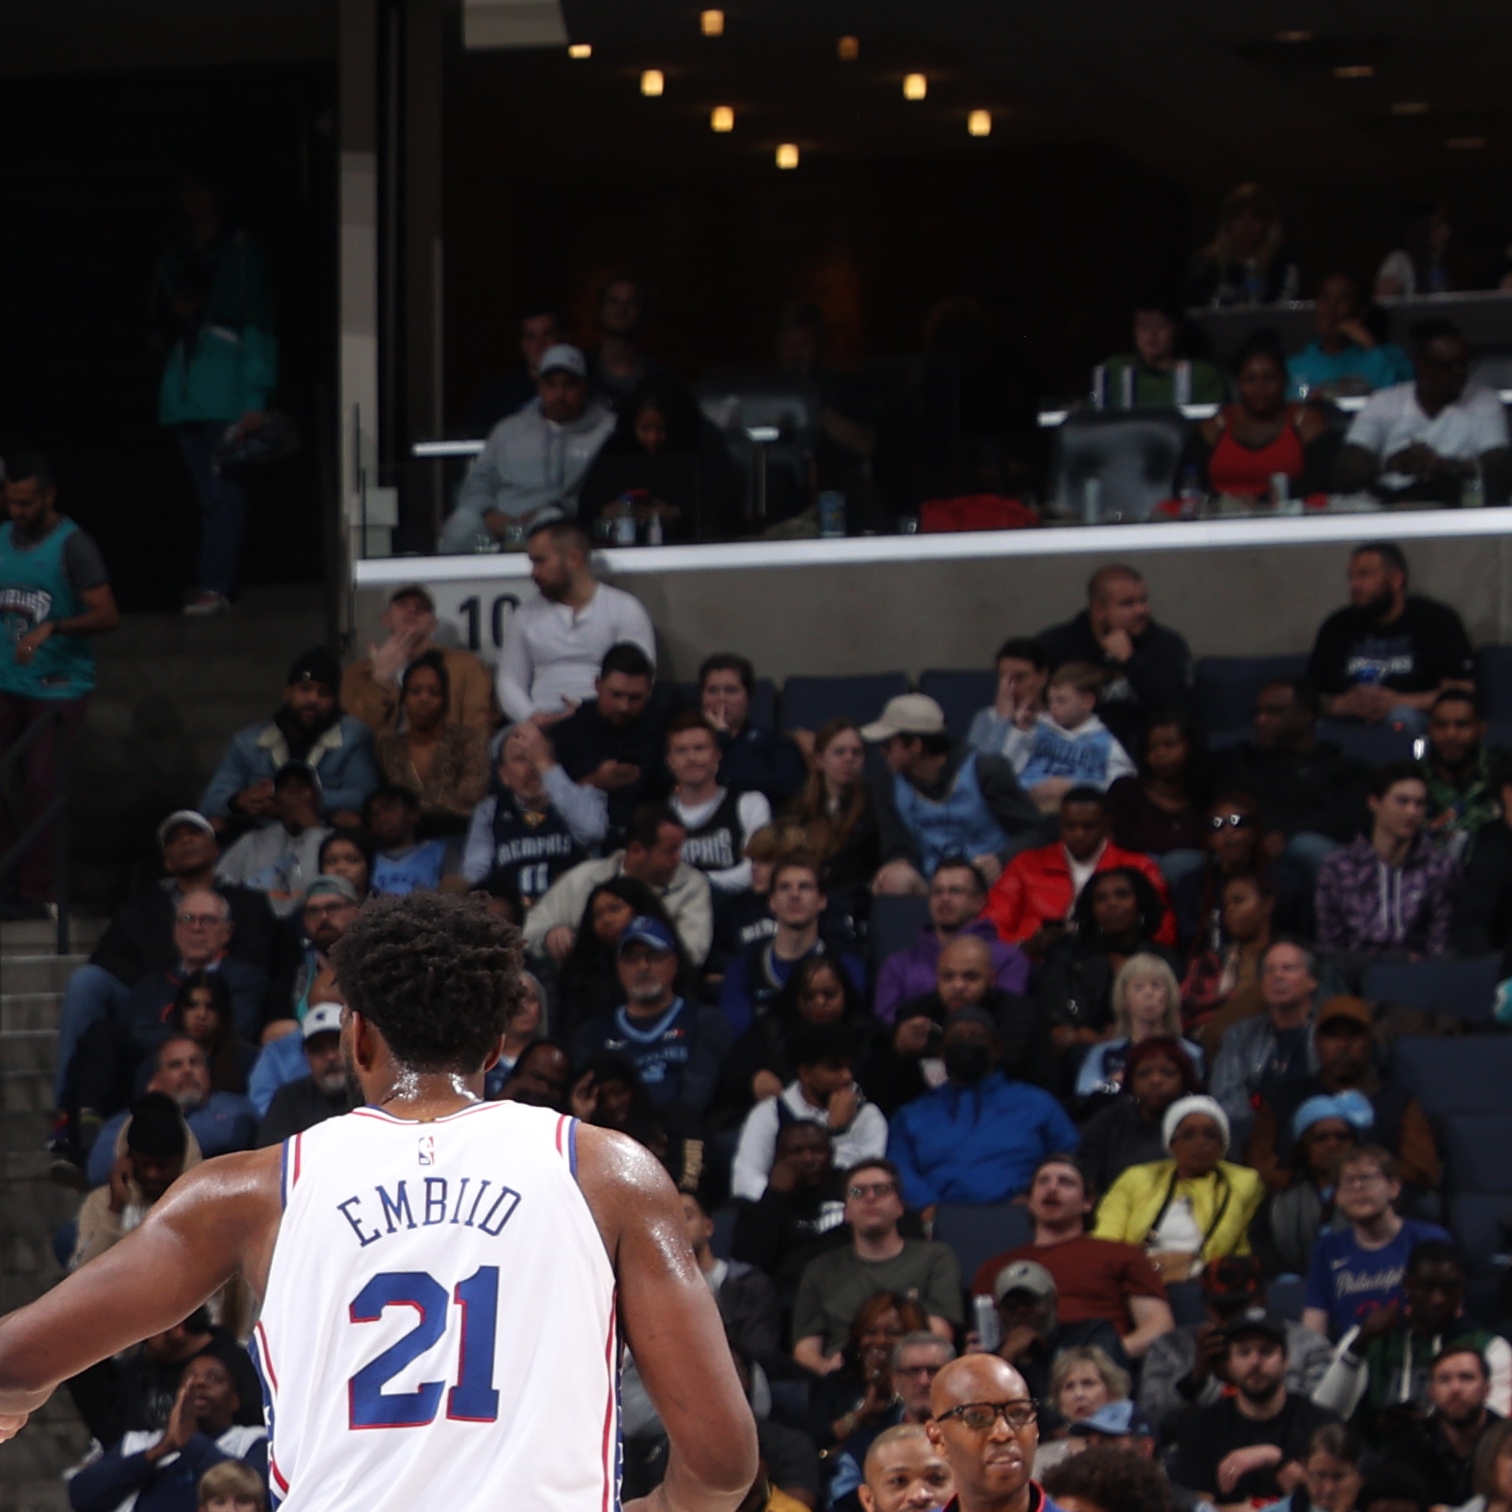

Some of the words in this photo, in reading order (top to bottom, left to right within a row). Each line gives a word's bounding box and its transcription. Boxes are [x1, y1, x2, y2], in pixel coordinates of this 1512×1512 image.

[498, 833, 575, 865] MEMPHIS
[681, 828, 732, 866] PHIS
[336, 1177, 522, 1248] EMBIID
[348, 1265, 501, 1431] 21
